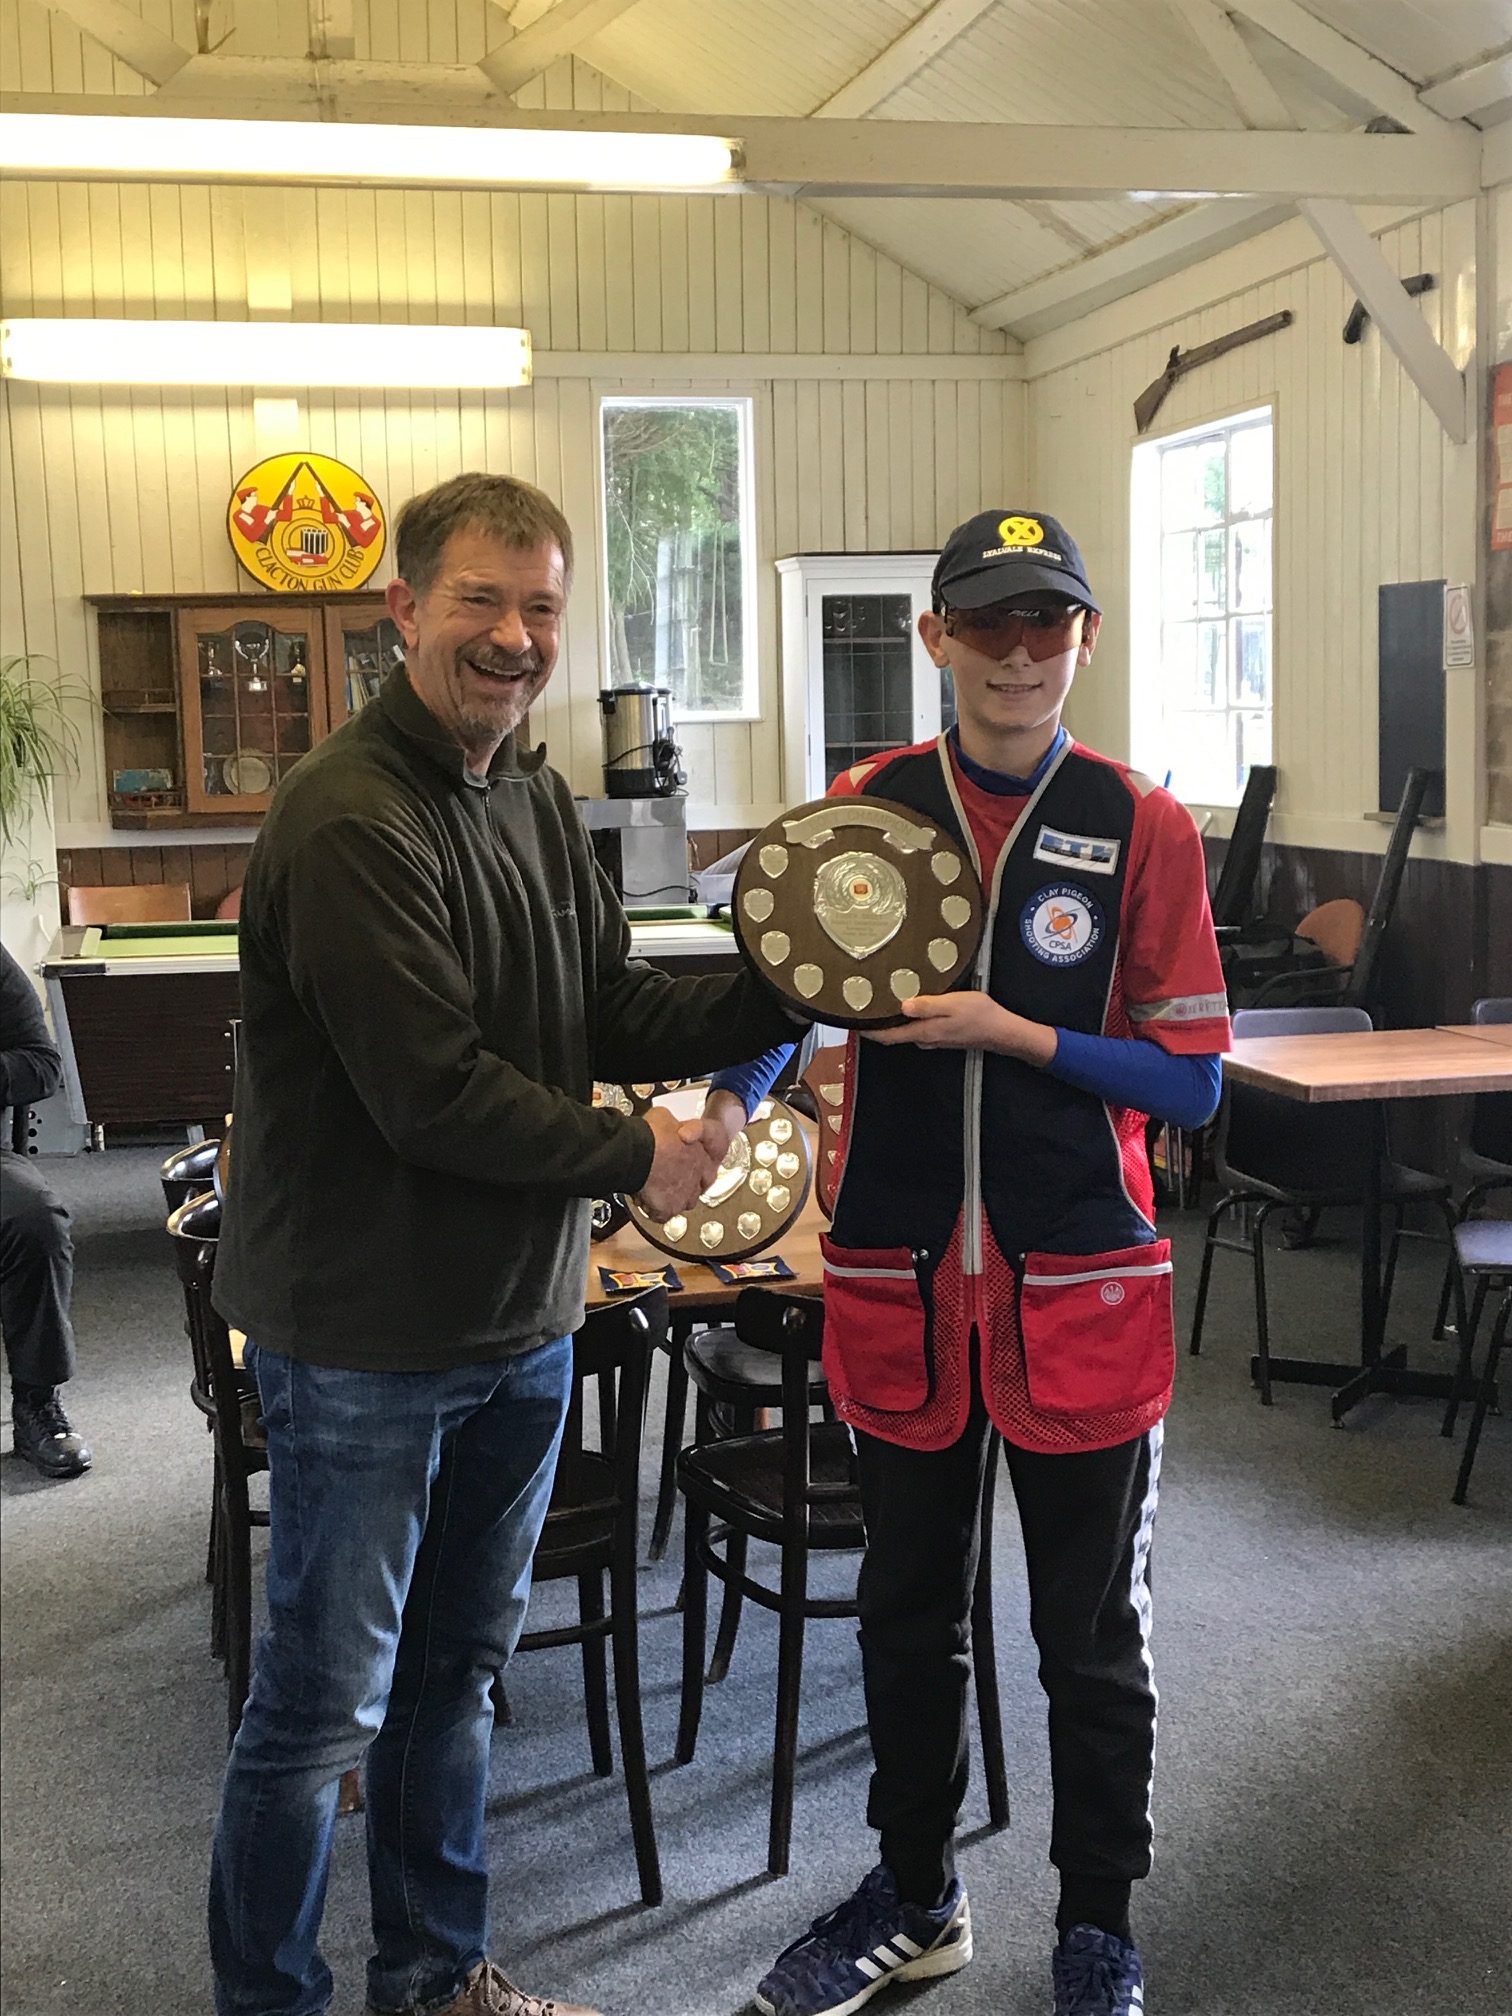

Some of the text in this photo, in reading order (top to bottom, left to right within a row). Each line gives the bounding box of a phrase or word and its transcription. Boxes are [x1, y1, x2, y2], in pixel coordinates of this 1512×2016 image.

[1026, 546, 1062, 561] EXPRESS
[255, 547, 365, 591] CLACTON GUN CLUB
[1037, 888, 1094, 908] CLAY PIGEON
[1024, 918, 1100, 963] SHOOTING ASSOCIATION
[1049, 940, 1072, 951] CPSA
